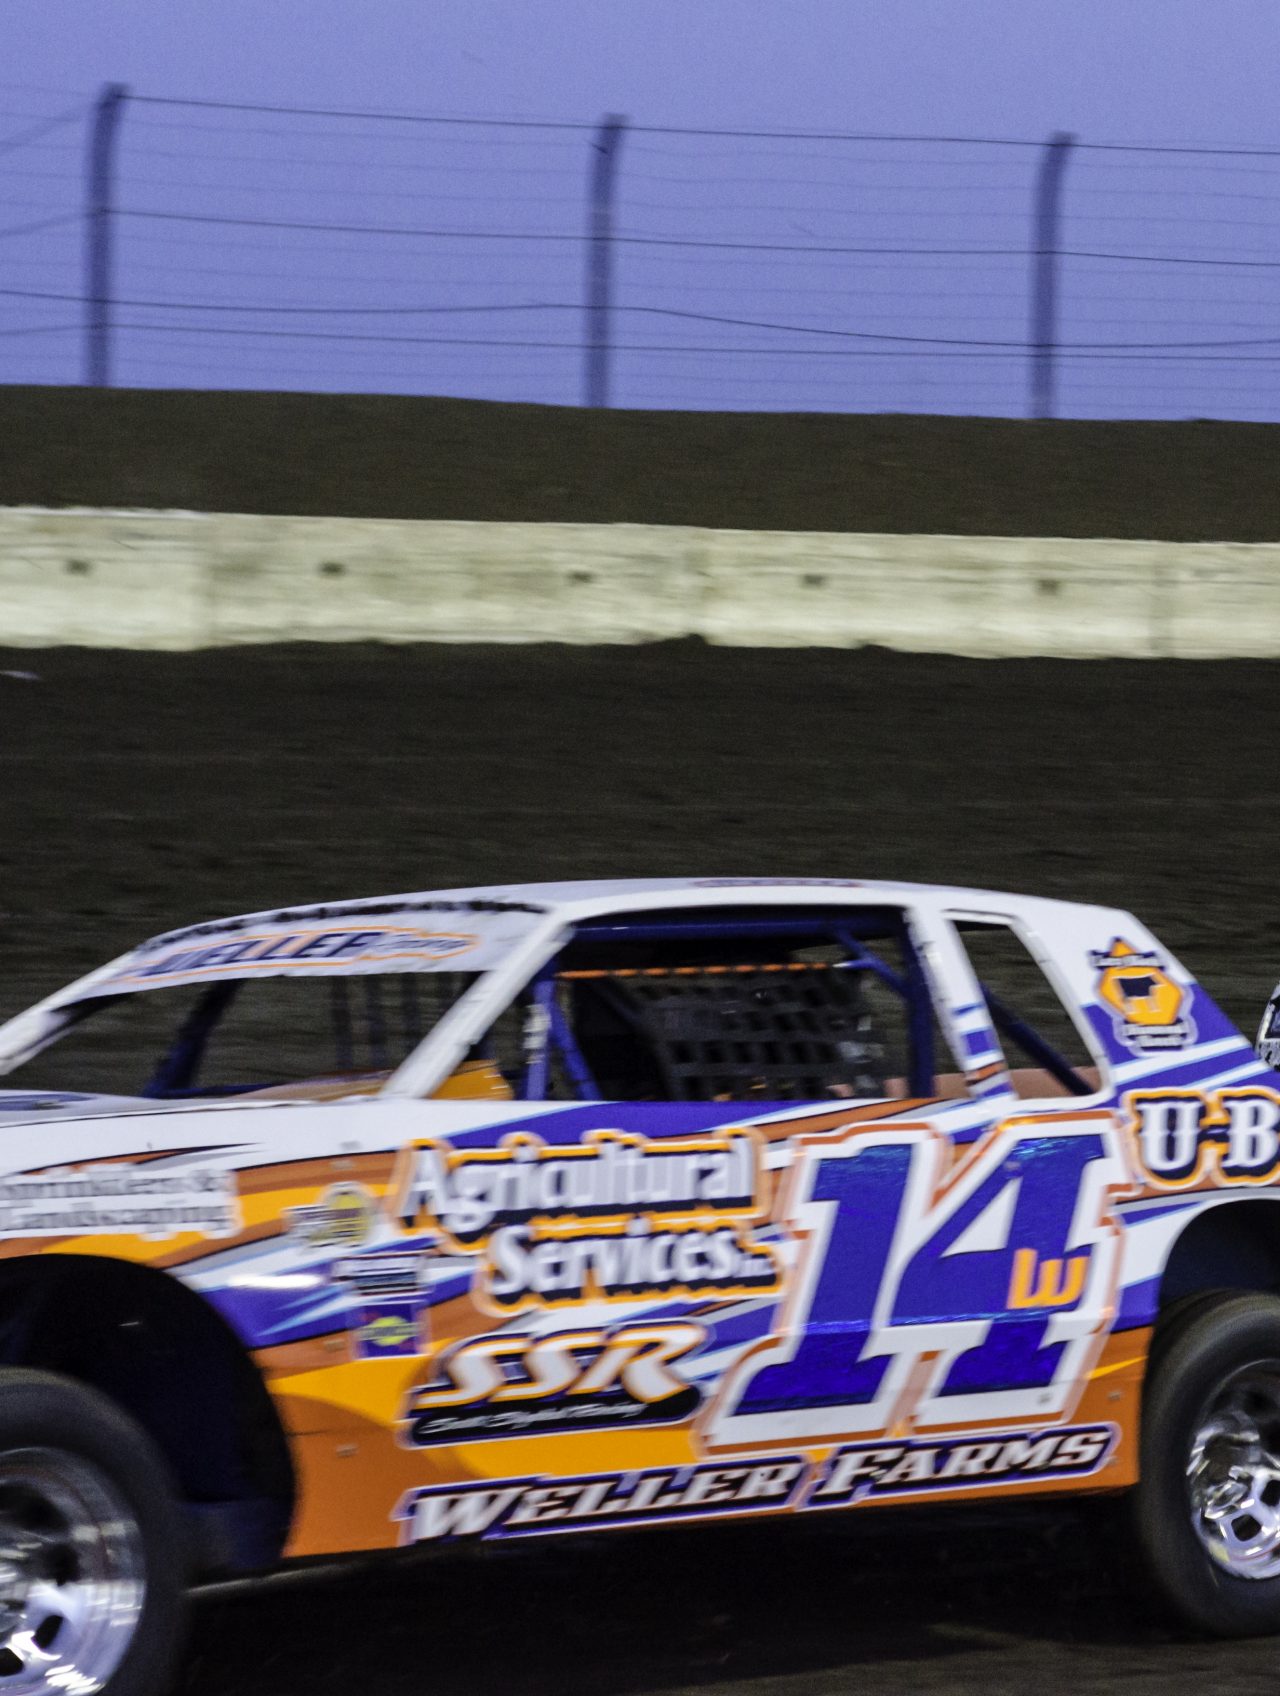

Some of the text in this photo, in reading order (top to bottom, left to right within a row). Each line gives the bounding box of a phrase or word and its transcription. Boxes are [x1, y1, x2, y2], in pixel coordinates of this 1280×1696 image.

[399, 1136, 755, 1233] Agricultural
[487, 1224, 740, 1294] Services
[718, 1123, 1120, 1432] 14
[413, 1325, 706, 1408] SSR
[417, 1428, 1111, 1541] WELLER FARMS
